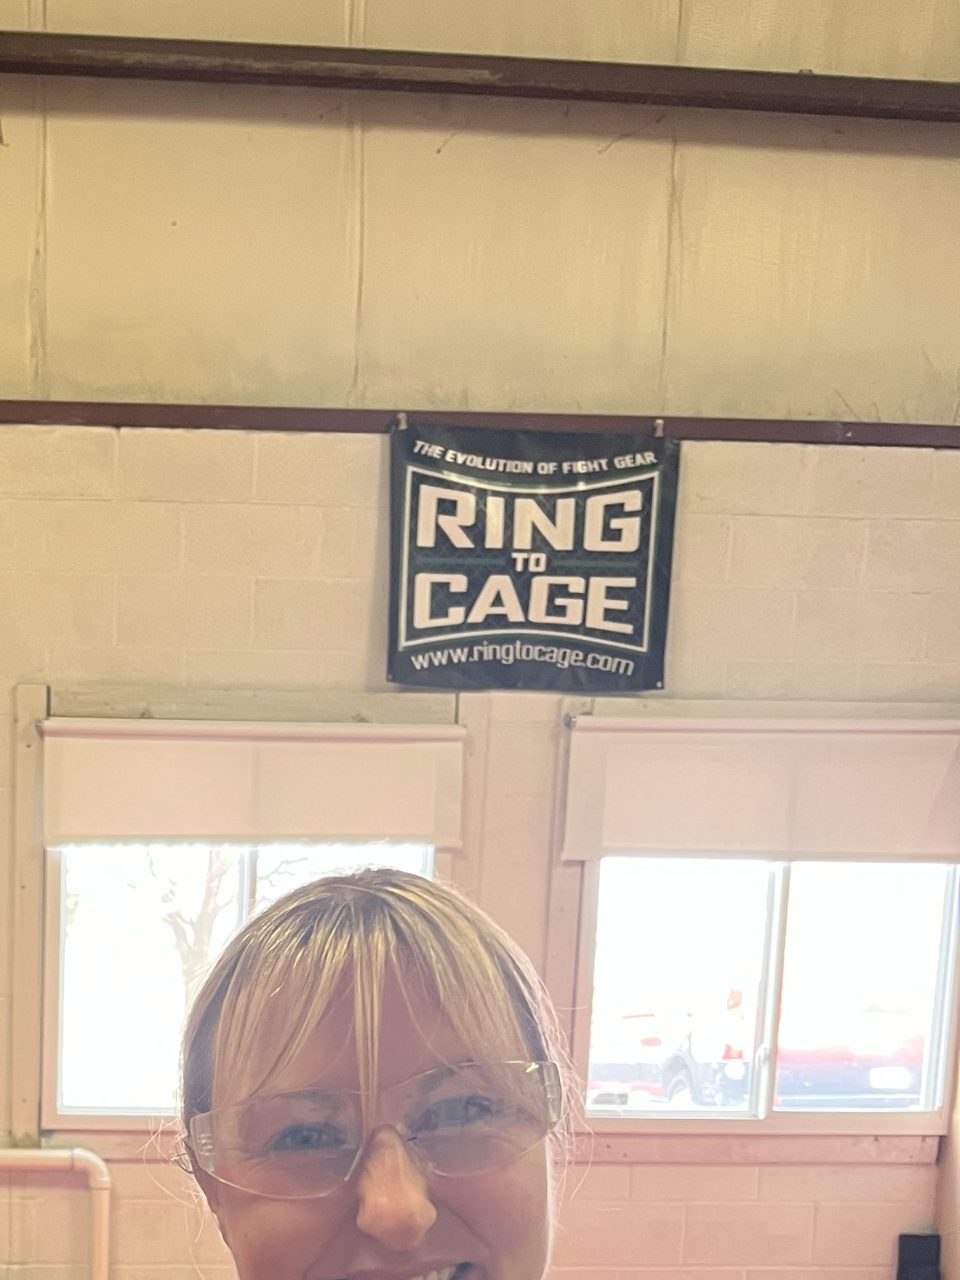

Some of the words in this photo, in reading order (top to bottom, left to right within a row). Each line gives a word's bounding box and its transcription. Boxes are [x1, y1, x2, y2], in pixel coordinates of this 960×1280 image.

[413, 440, 443, 460] THE
[444, 449, 534, 474] EVOLUTION
[537, 461, 558, 475] OF
[562, 458, 609, 475] FIGHT
[613, 451, 658, 469] GEAR
[416, 484, 643, 553] RING
[511, 552, 547, 572] TO
[413, 572, 637, 635] CAGE
